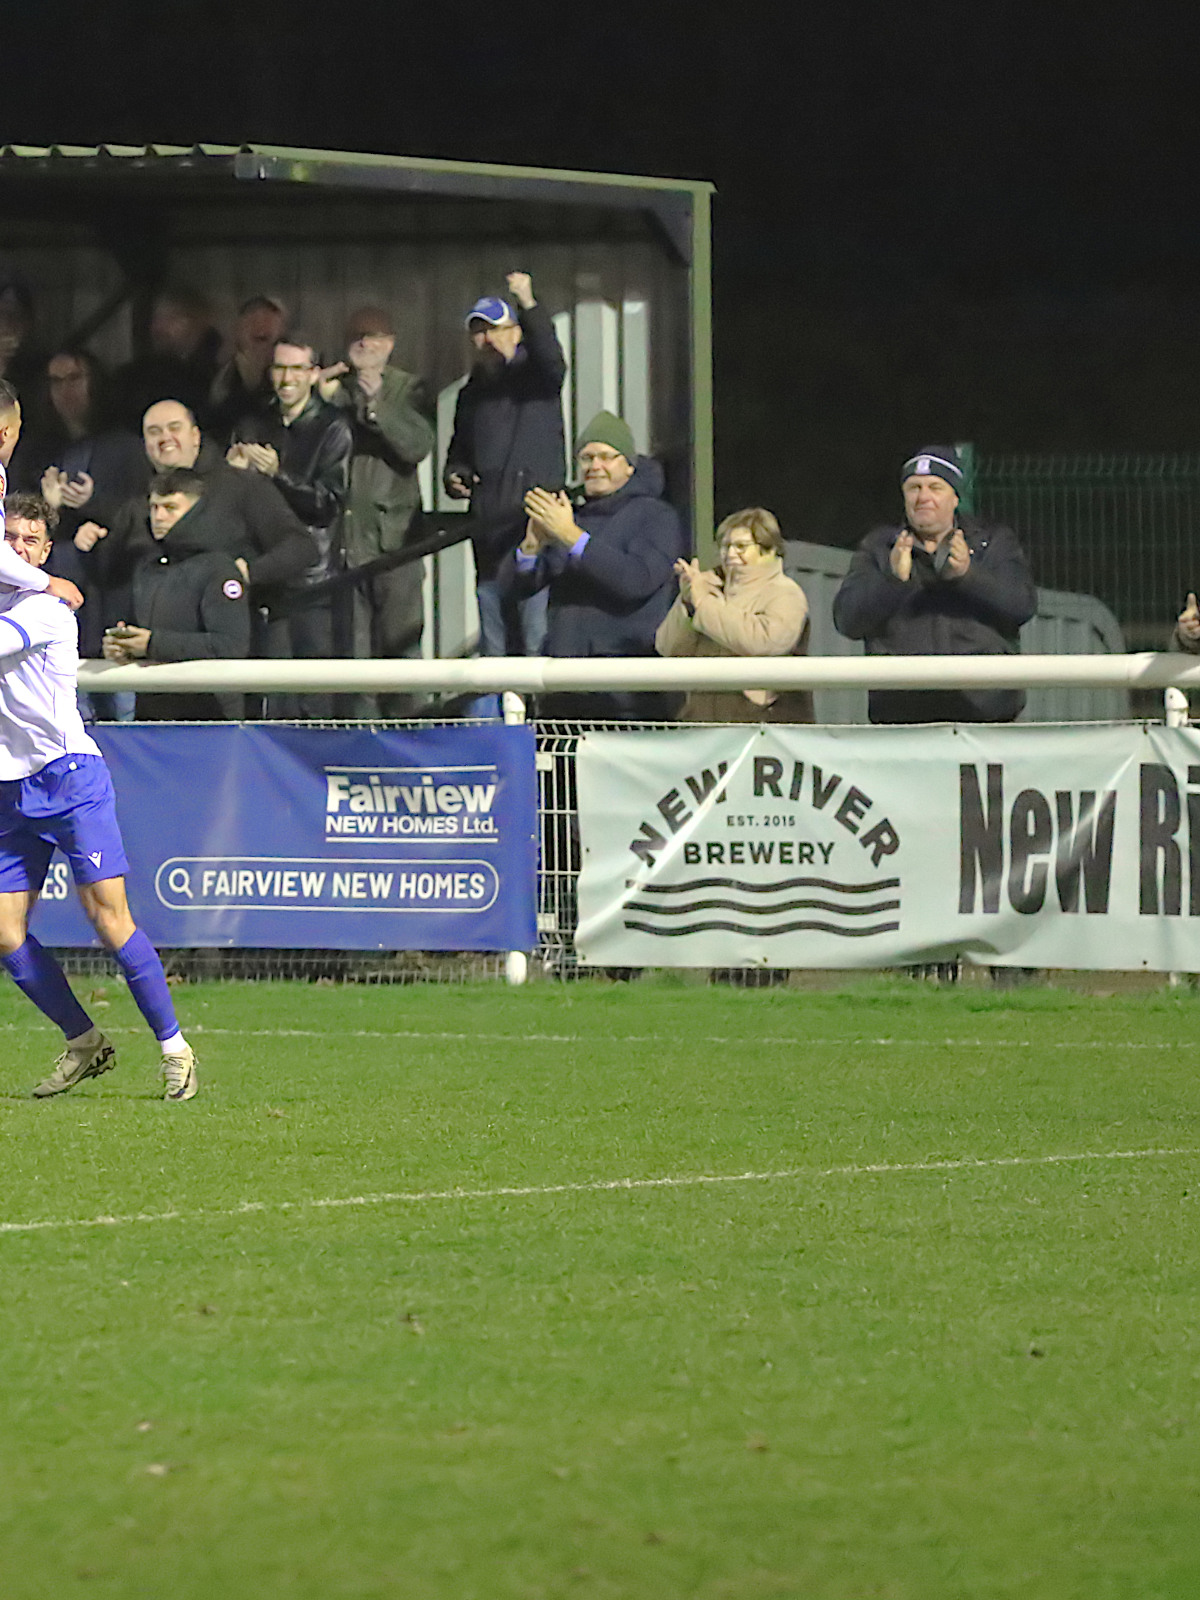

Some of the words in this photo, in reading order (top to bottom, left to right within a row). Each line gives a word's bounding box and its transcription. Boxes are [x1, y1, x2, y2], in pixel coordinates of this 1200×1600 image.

[326, 775, 496, 814] Fairview
[326, 815, 378, 833] NEW
[383, 815, 458, 834] HOMES
[463, 817, 499, 834] Ltd.
[629, 761, 727, 868] NEW
[753, 756, 900, 869] RIVER
[727, 815, 759, 827] EST.
[764, 815, 796, 827] 2015
[684, 841, 835, 864] BREWERY
[958, 763, 1117, 915] New
[202, 870, 325, 898] FAIRVIEW
[332, 871, 393, 899] NEW
[399, 872, 486, 899] HOMES
